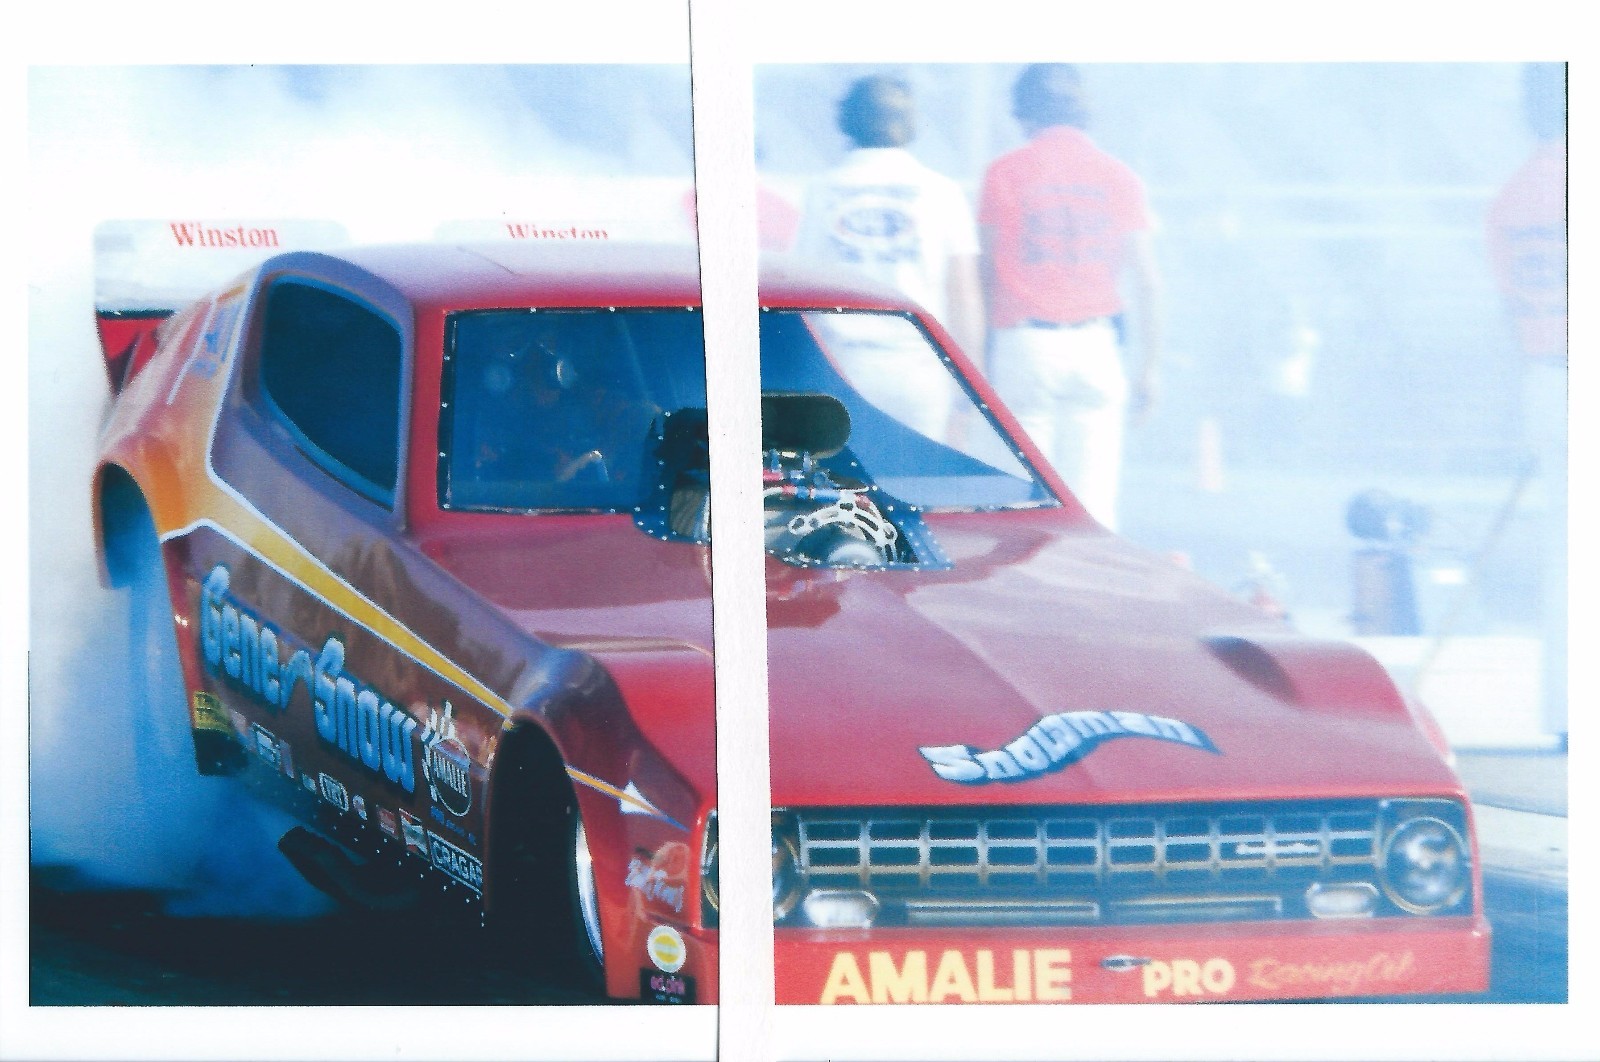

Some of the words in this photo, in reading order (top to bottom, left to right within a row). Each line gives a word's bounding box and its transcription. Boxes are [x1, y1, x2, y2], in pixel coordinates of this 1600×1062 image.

[170, 222, 280, 248] Winston
[201, 565, 279, 705] Gene
[314, 637, 417, 794] Snow
[919, 711, 1208, 783] Snowman
[821, 949, 1072, 1004] AMALIE
[1142, 957, 1235, 998] PRO
